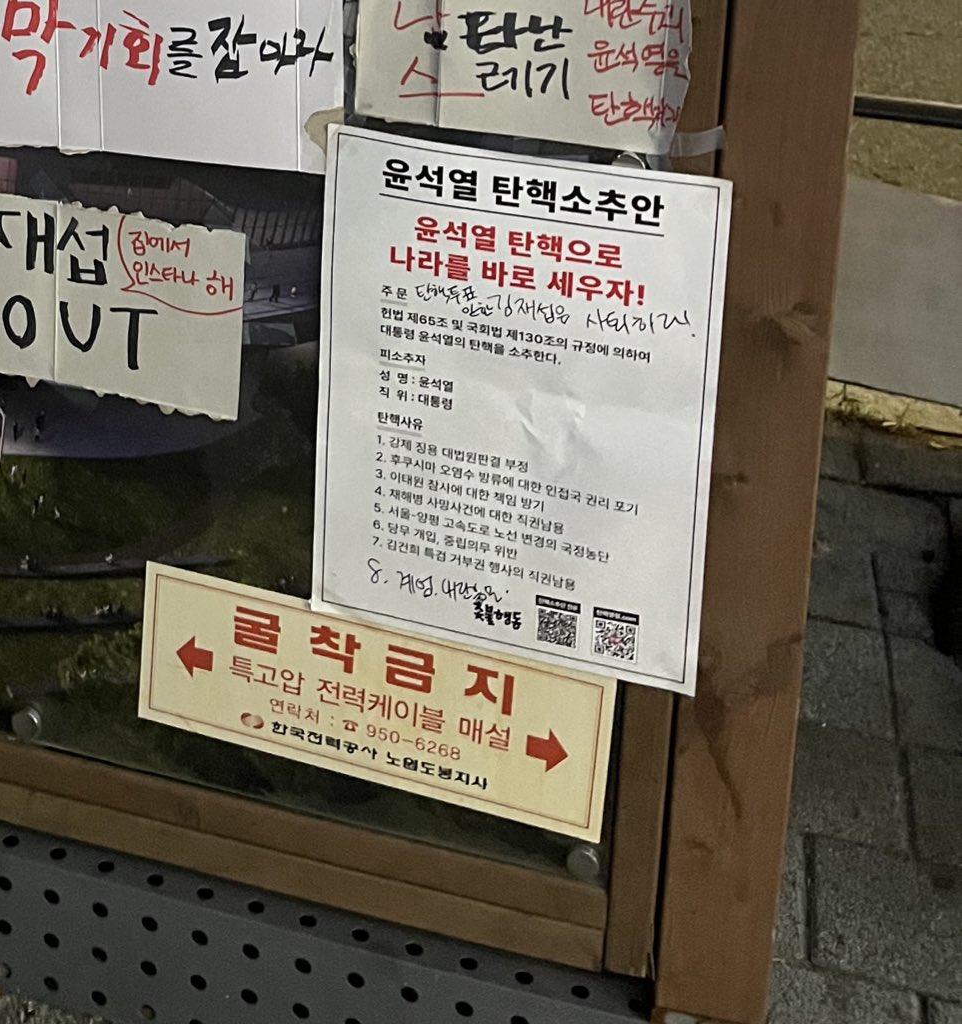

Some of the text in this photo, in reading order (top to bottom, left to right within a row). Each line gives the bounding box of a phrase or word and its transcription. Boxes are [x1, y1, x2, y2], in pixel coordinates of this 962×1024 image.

[381, 158, 666, 228] 윤석열 탄핵소추안
[414, 216, 623, 270] 윤석열 탄핵으로
[389, 245, 646, 307] 나라를 바로 세우자!
[1, 294, 159, 371] OUT
[380, 324, 562, 366] 대통령 윤석열의 탄핵을 소추한다.
[381, 307, 651, 364] 헌법 제65조 및 국회법 제130조의 규정에 의하여
[380, 348, 426, 366] 피소추자
[417, 393, 454, 411] 대통령
[418, 376, 455, 394] 윤석열
[377, 411, 424, 431] 탄핵사유
[390, 454, 436, 475] 후쿠시마
[517, 478, 543, 494] 대한
[545, 484, 582, 503] 인접국
[585, 493, 610, 510] 권리
[613, 500, 639, 516] 포기
[505, 458, 529, 474] 부정
[390, 471, 425, 489] 이태원
[465, 487, 490, 502] 대한
[520, 496, 545, 513] 방기
[488, 509, 513, 524] 대한
[493, 527, 518, 543] 노선
[386, 538, 421, 556] 김건희
[494, 544, 518, 560] 위반
[228, 656, 512, 753] 특고압 전력케이블 매설
[269, 697, 462, 762] 연락처 950-6268
[270, 719, 490, 792] 한국전력공사 노원도봉지사
